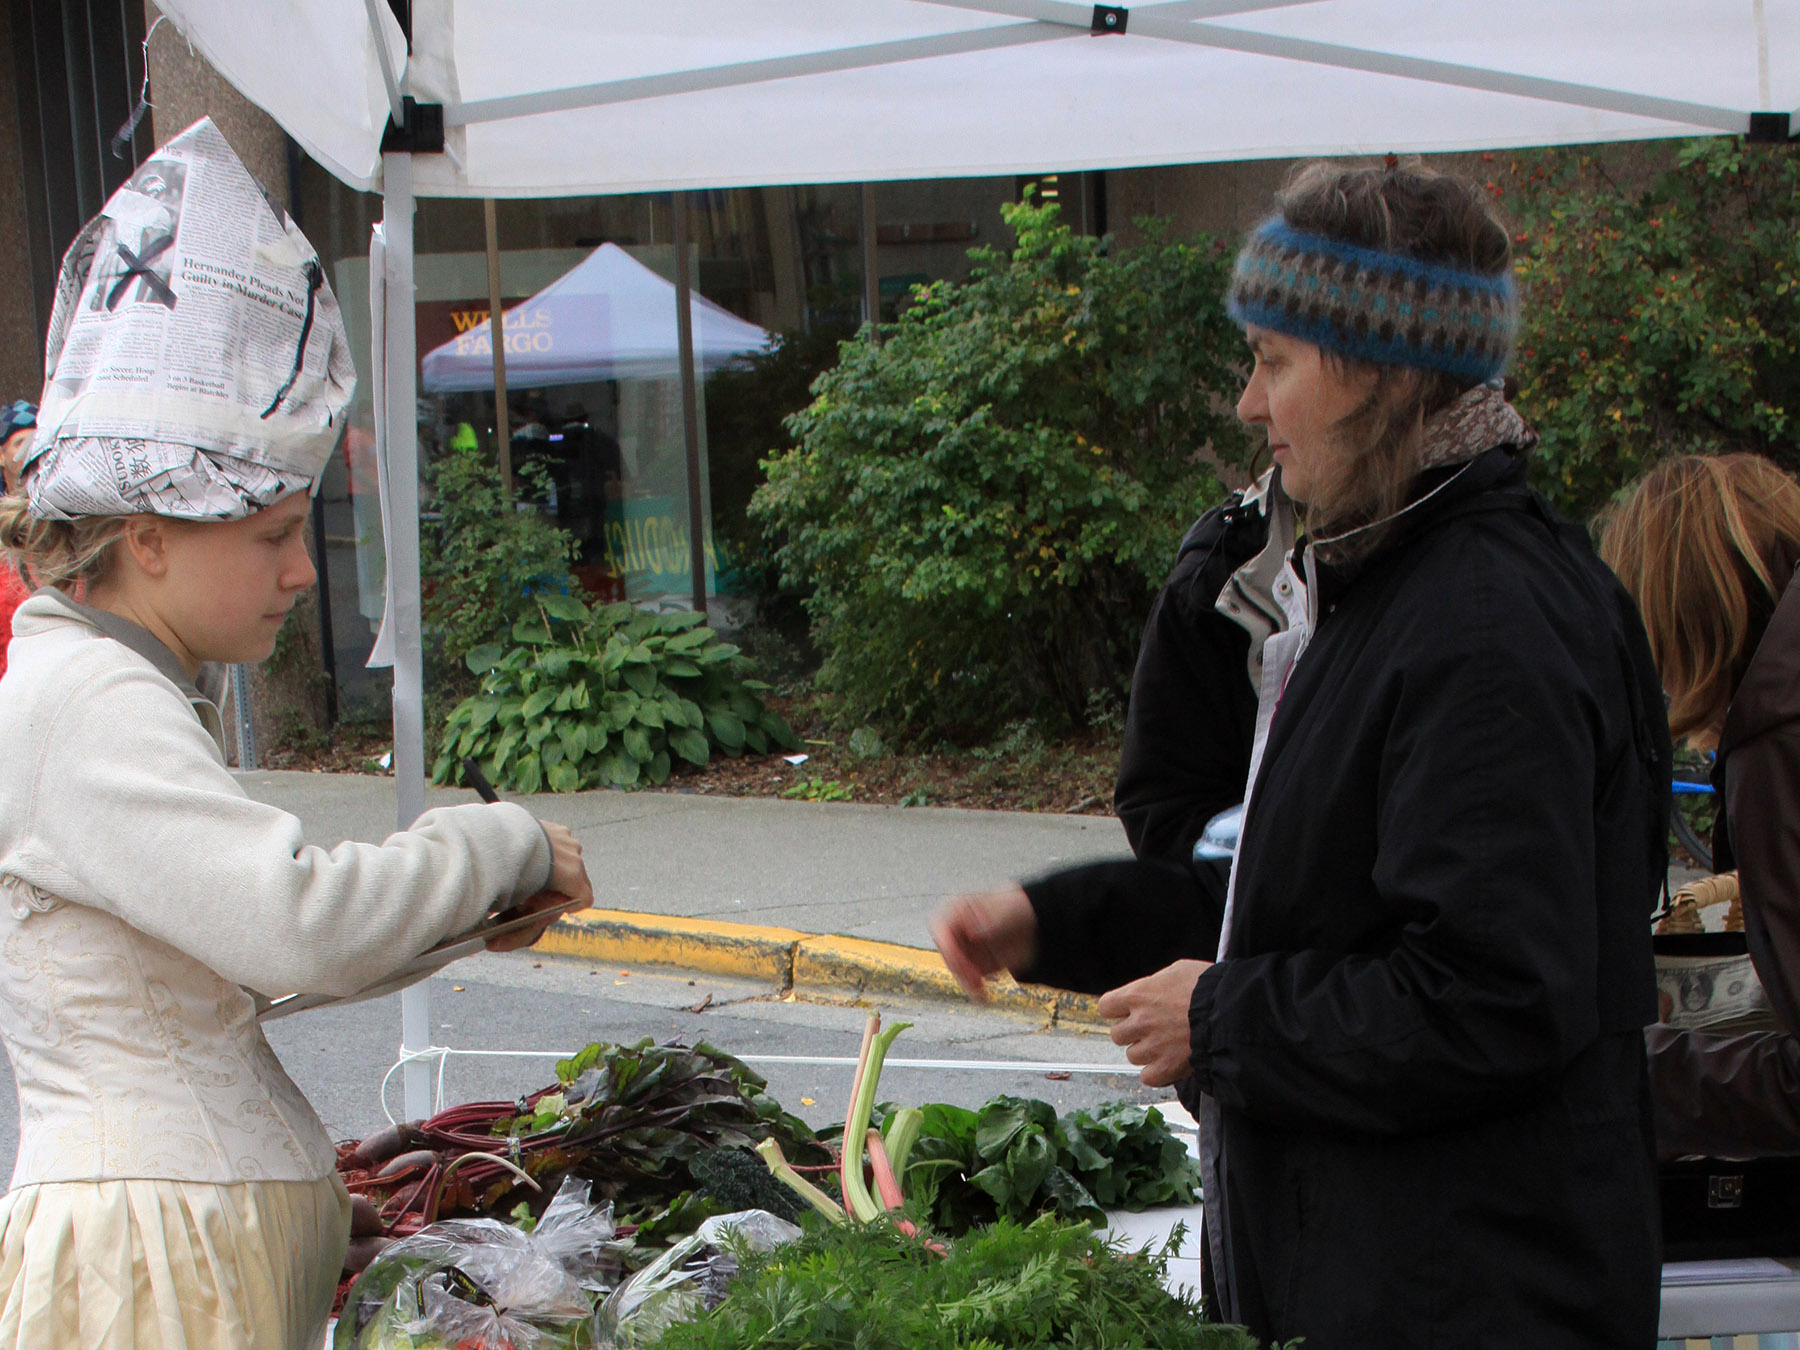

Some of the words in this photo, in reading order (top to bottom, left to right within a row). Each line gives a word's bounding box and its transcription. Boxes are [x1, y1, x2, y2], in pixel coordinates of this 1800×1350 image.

[182, 270, 219, 288] Guilty
[222, 278, 235, 291] in
[236, 283, 278, 309] Murder
[279, 301, 305, 320] Case
[183, 257, 247, 282] Hernandez
[249, 275, 284, 298] Pleads
[287, 290, 304, 307] Not
[451, 309, 552, 331] WELLS
[455, 331, 552, 356] FARGO
[108, 439, 132, 490] SUDOK
